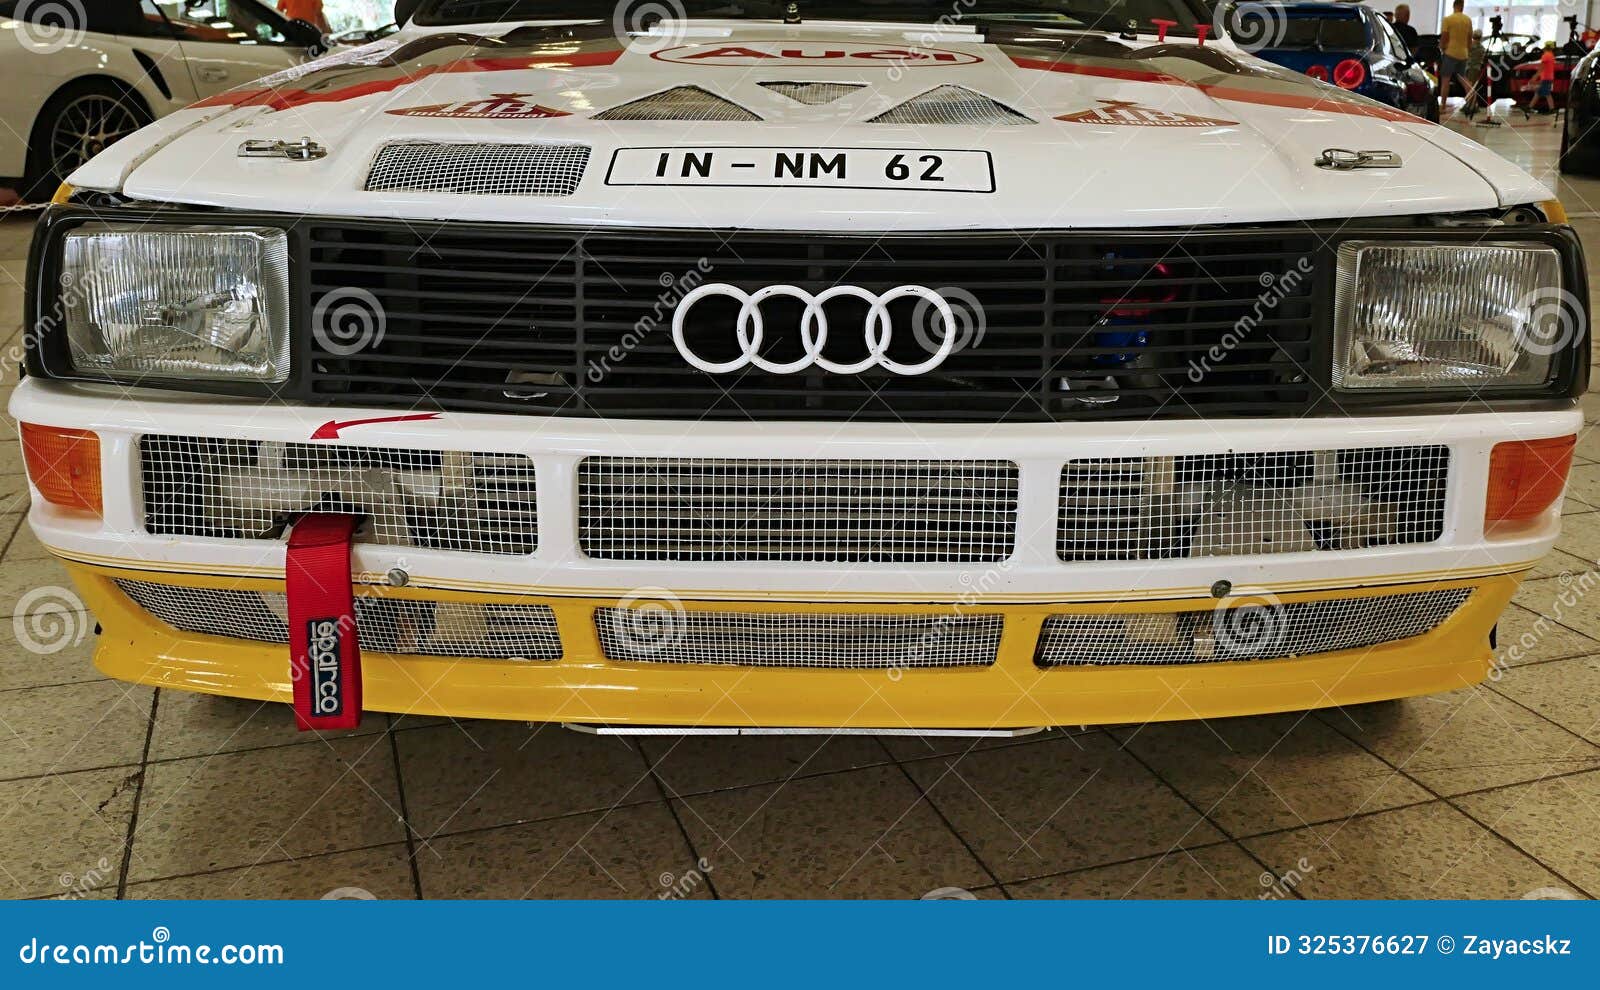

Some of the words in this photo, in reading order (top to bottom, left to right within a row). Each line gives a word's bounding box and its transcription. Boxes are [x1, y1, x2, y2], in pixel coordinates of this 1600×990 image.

[678, 47, 957, 62] Audi
[440, 101, 536, 114] HB
[1092, 108, 1187, 122] HB
[656, 152, 713, 178] IN
[774, 153, 846, 179] NM
[885, 154, 945, 182] 62
[310, 621, 338, 714] sparco
